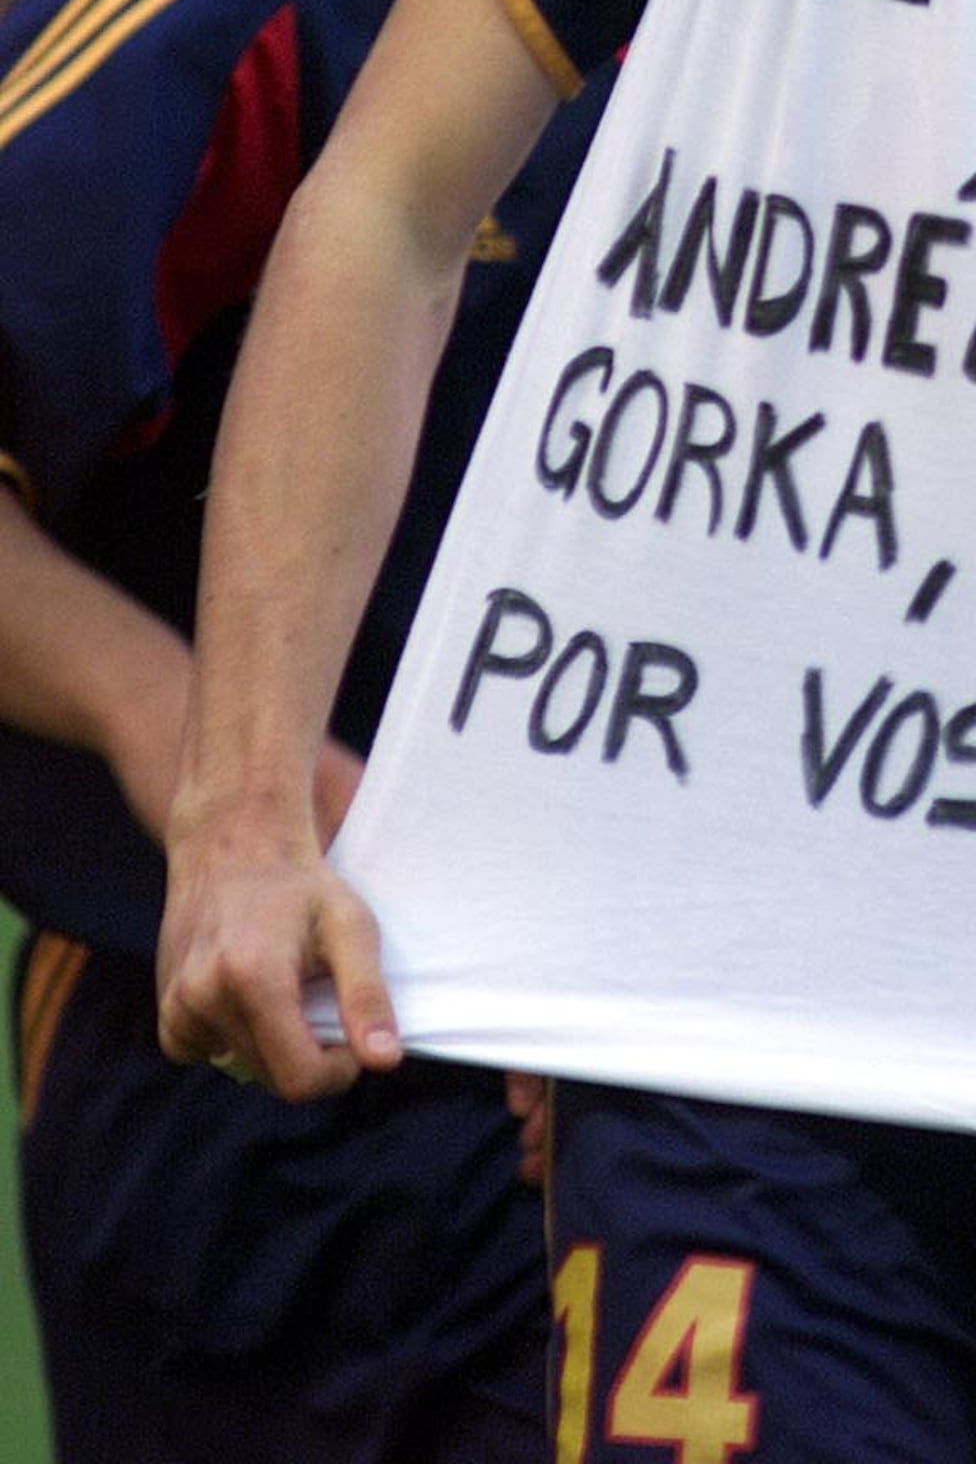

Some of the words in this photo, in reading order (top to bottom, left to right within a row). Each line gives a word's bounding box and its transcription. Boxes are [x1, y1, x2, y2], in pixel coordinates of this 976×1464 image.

[536, 344, 957, 624] GORKA,
[449, 587, 700, 785] POR
[550, 1242, 762, 1464] 14
